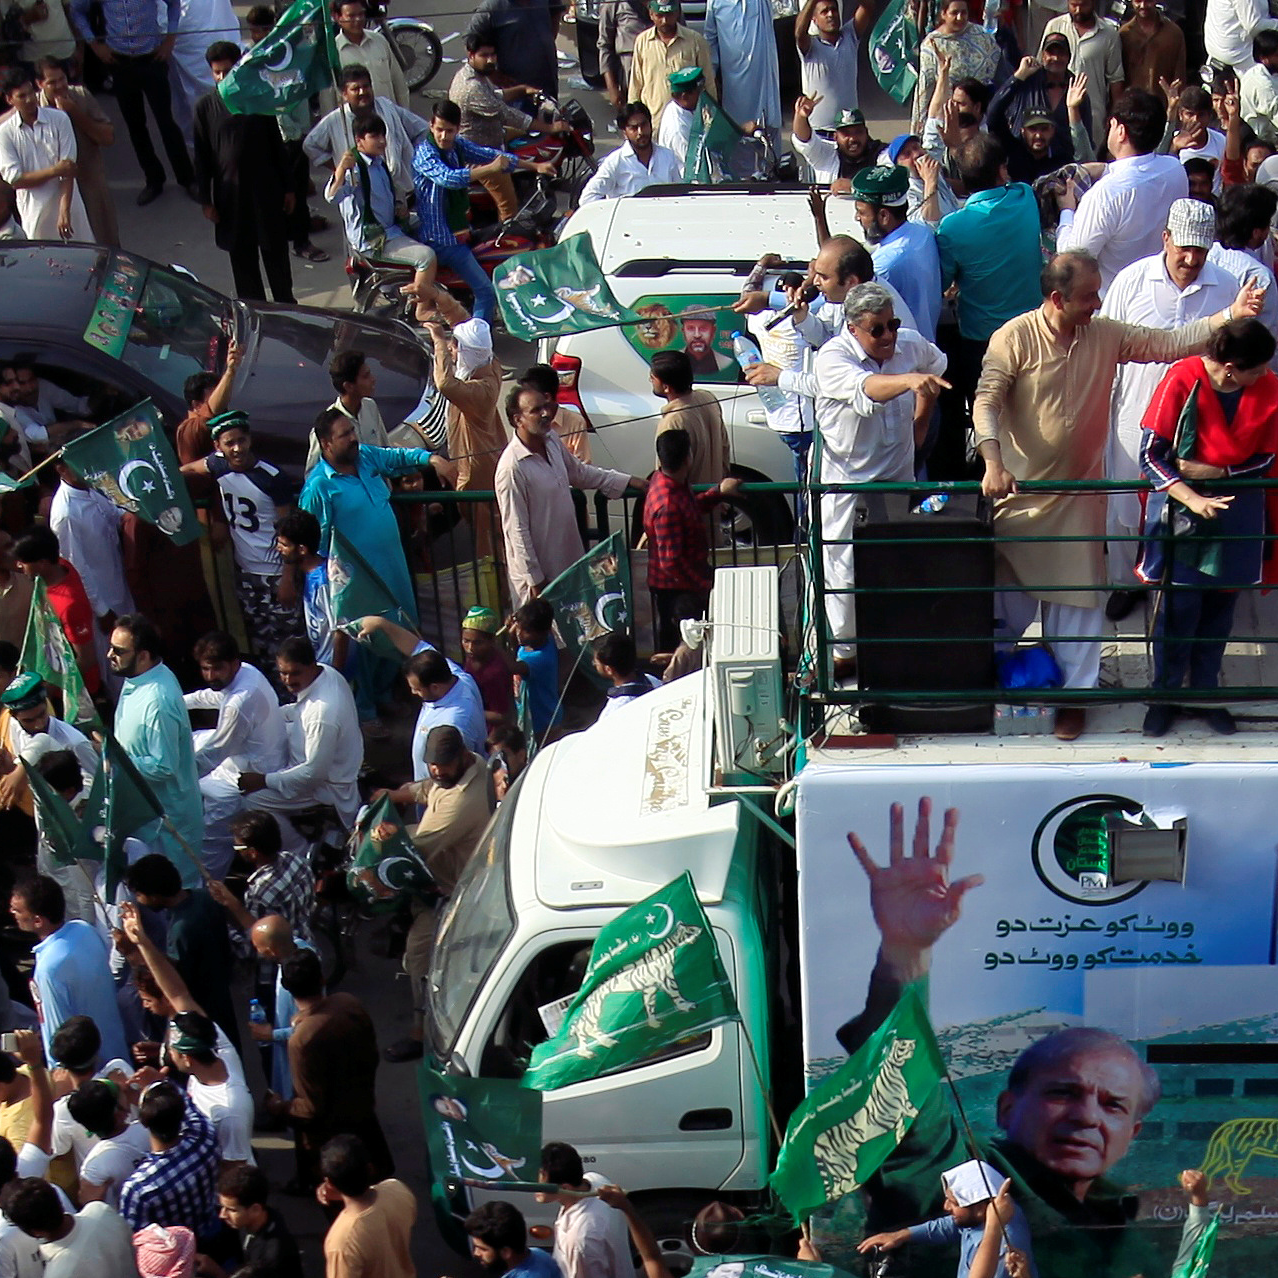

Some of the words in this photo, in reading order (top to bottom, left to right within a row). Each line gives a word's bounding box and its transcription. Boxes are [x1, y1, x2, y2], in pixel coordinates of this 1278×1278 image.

[224, 493, 261, 533] 13
[995, 917, 1027, 938] دو
[1030, 914, 1103, 938] عزت
[1105, 913, 1138, 938] کو
[1135, 915, 1194, 939] ووٹ
[984, 949, 1015, 970] دو
[1018, 947, 1079, 970] ووٹ
[1083, 946, 1113, 969] کو
[1111, 943, 1203, 964] خدمت
